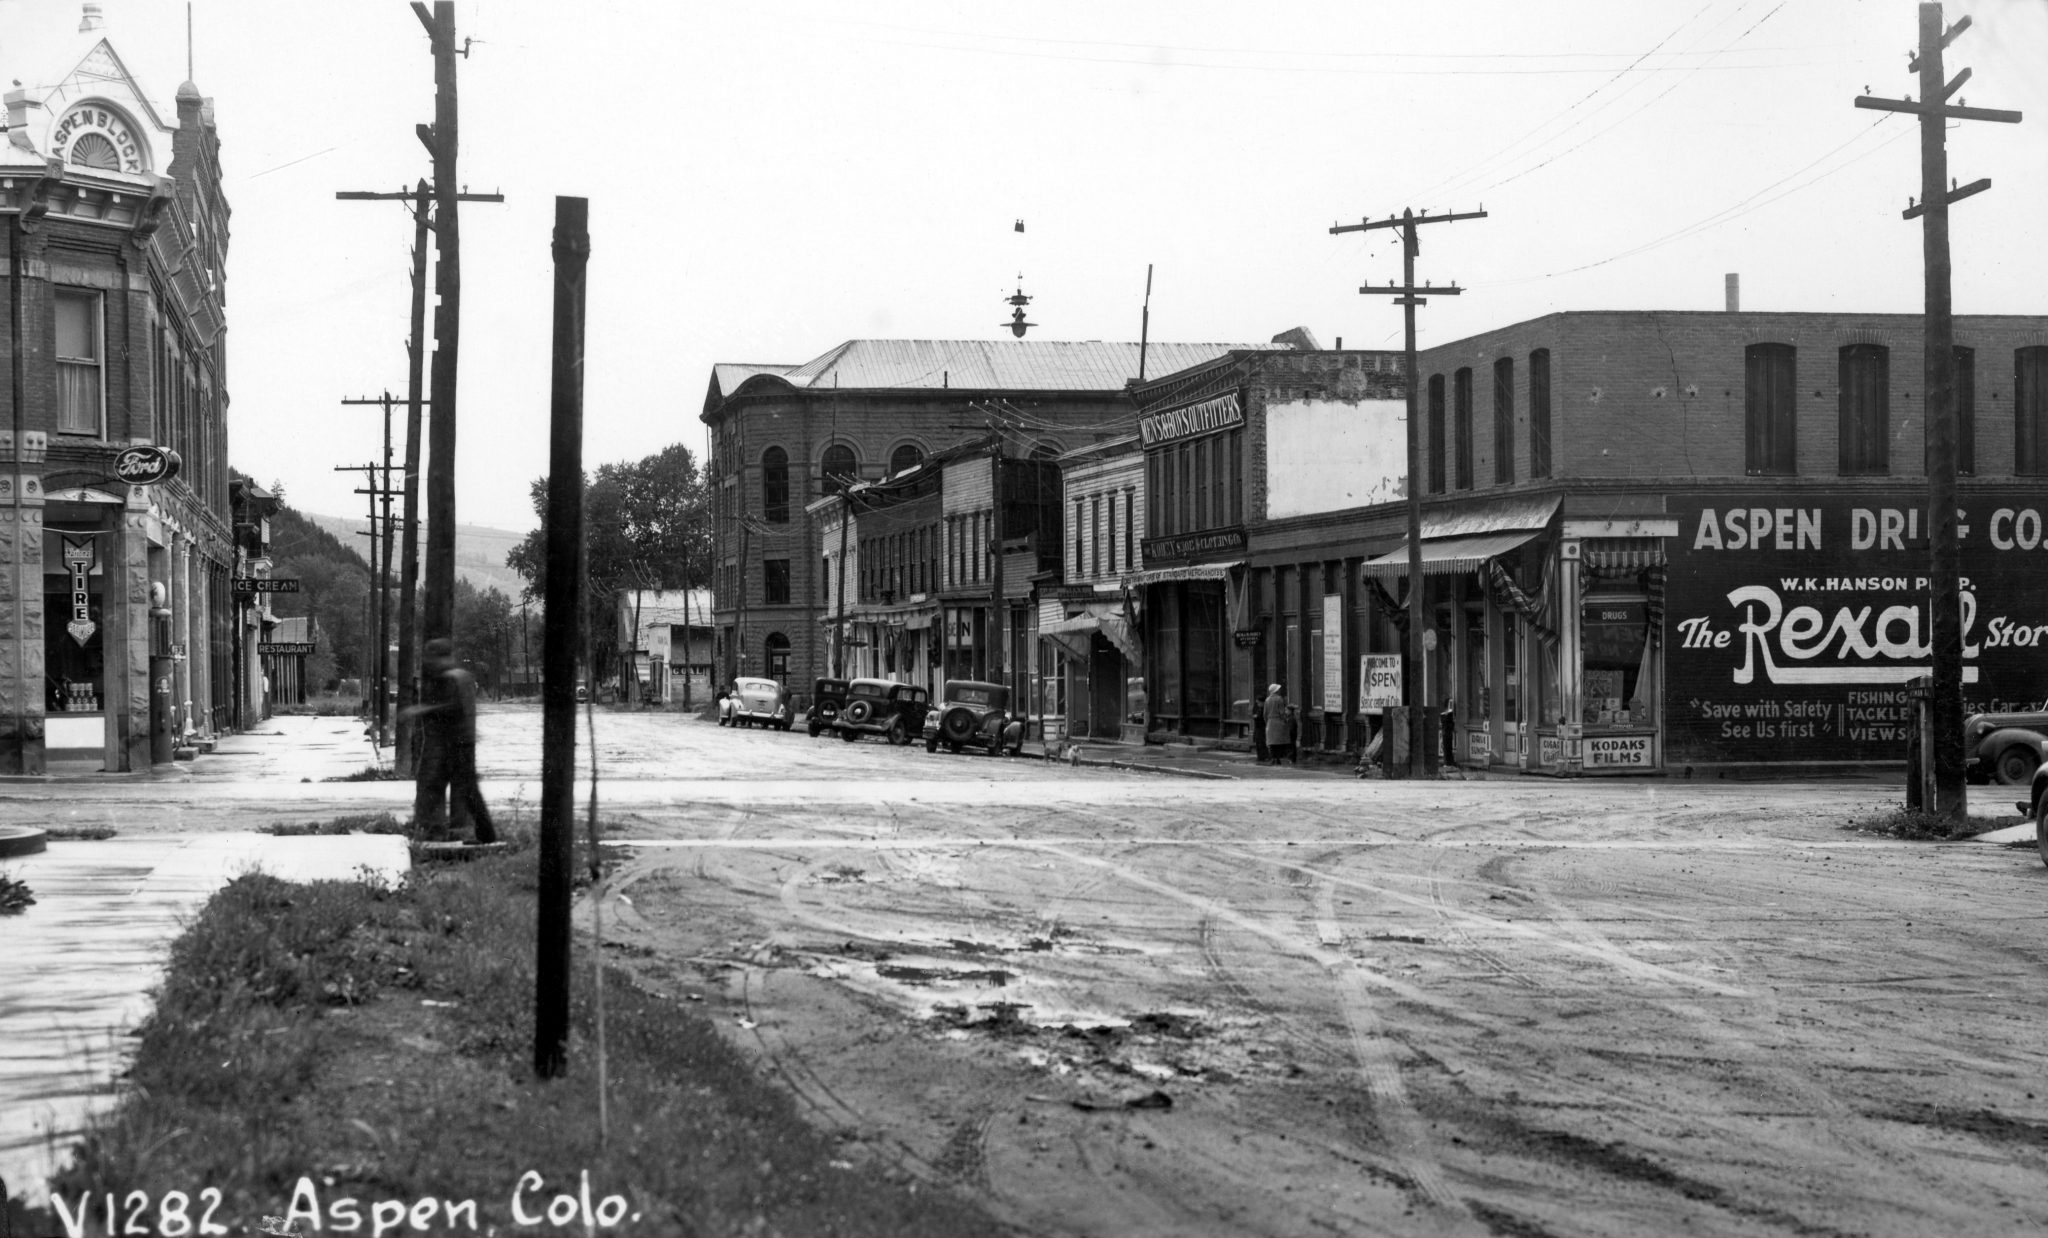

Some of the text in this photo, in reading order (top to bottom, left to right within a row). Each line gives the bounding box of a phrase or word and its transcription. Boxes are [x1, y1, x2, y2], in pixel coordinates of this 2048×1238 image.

[52, 110, 139, 171] ASPEN BLOCK
[118, 452, 162, 476] Ford
[1693, 508, 1822, 550] ASPEN
[233, 581, 297, 591] ICE CREAM
[1915, 577, 1977, 591] PP.
[72, 561, 88, 621] TIRE
[1602, 611, 1627, 620] DRUGS
[1677, 615, 1731, 649] The
[1727, 586, 1979, 685] Rexal
[258, 644, 314, 653] RESTAURANT
[1389, 657, 1396, 669] TO
[1848, 691, 1908, 704] FISHING
[1745, 699, 1780, 718] with
[1784, 700, 1832, 720] Safety
[1846, 707, 1908, 720] TACKLE
[1721, 720, 1815, 738] See Us first
[1849, 728, 1907, 741] VIEWS
[1591, 740, 1645, 751] KODAKS
[1593, 752, 1642, 764] FILMS
